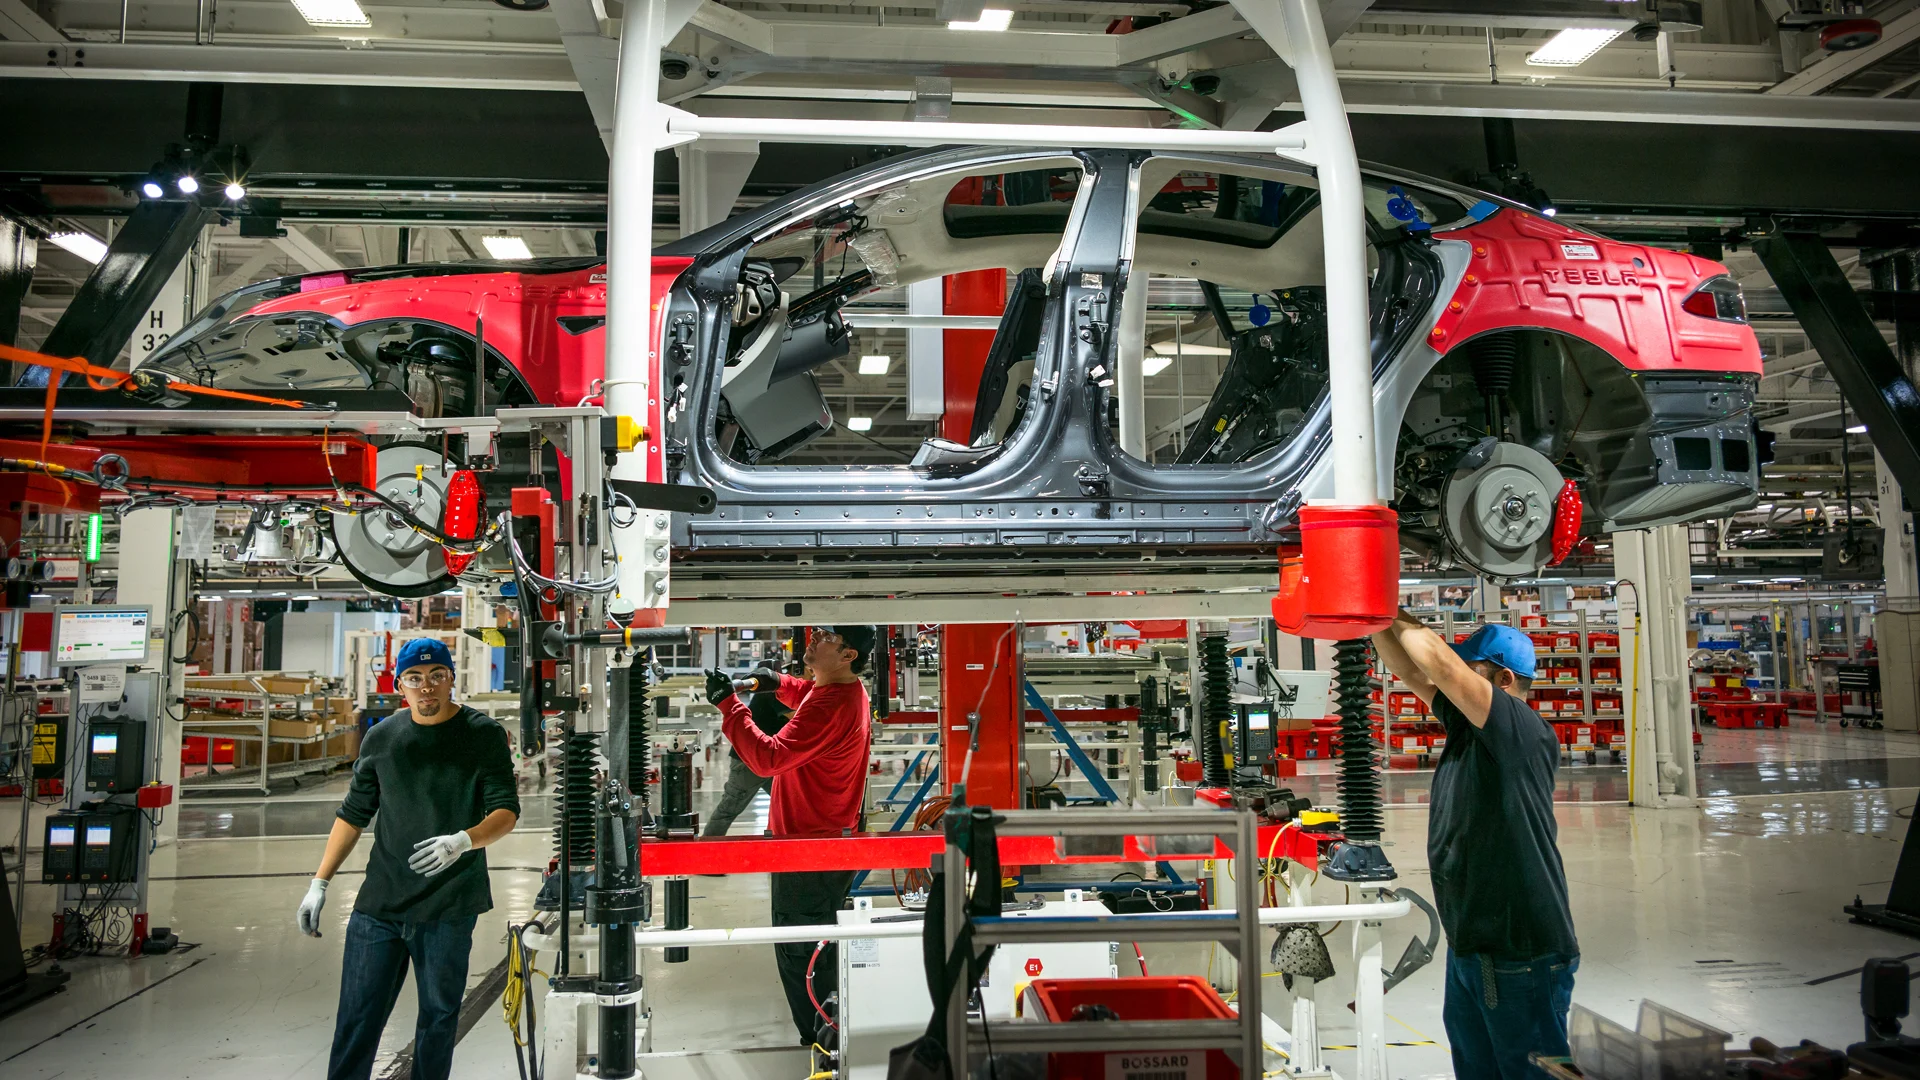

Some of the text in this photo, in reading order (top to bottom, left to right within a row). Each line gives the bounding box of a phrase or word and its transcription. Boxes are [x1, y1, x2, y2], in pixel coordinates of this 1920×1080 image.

[1543, 268, 1639, 286] TESLA
[150, 310, 163, 328] H
[1882, 475, 1887, 484] J
[1880, 485, 1890, 495] 31
[1121, 1055, 1189, 1069] BOSSARD
